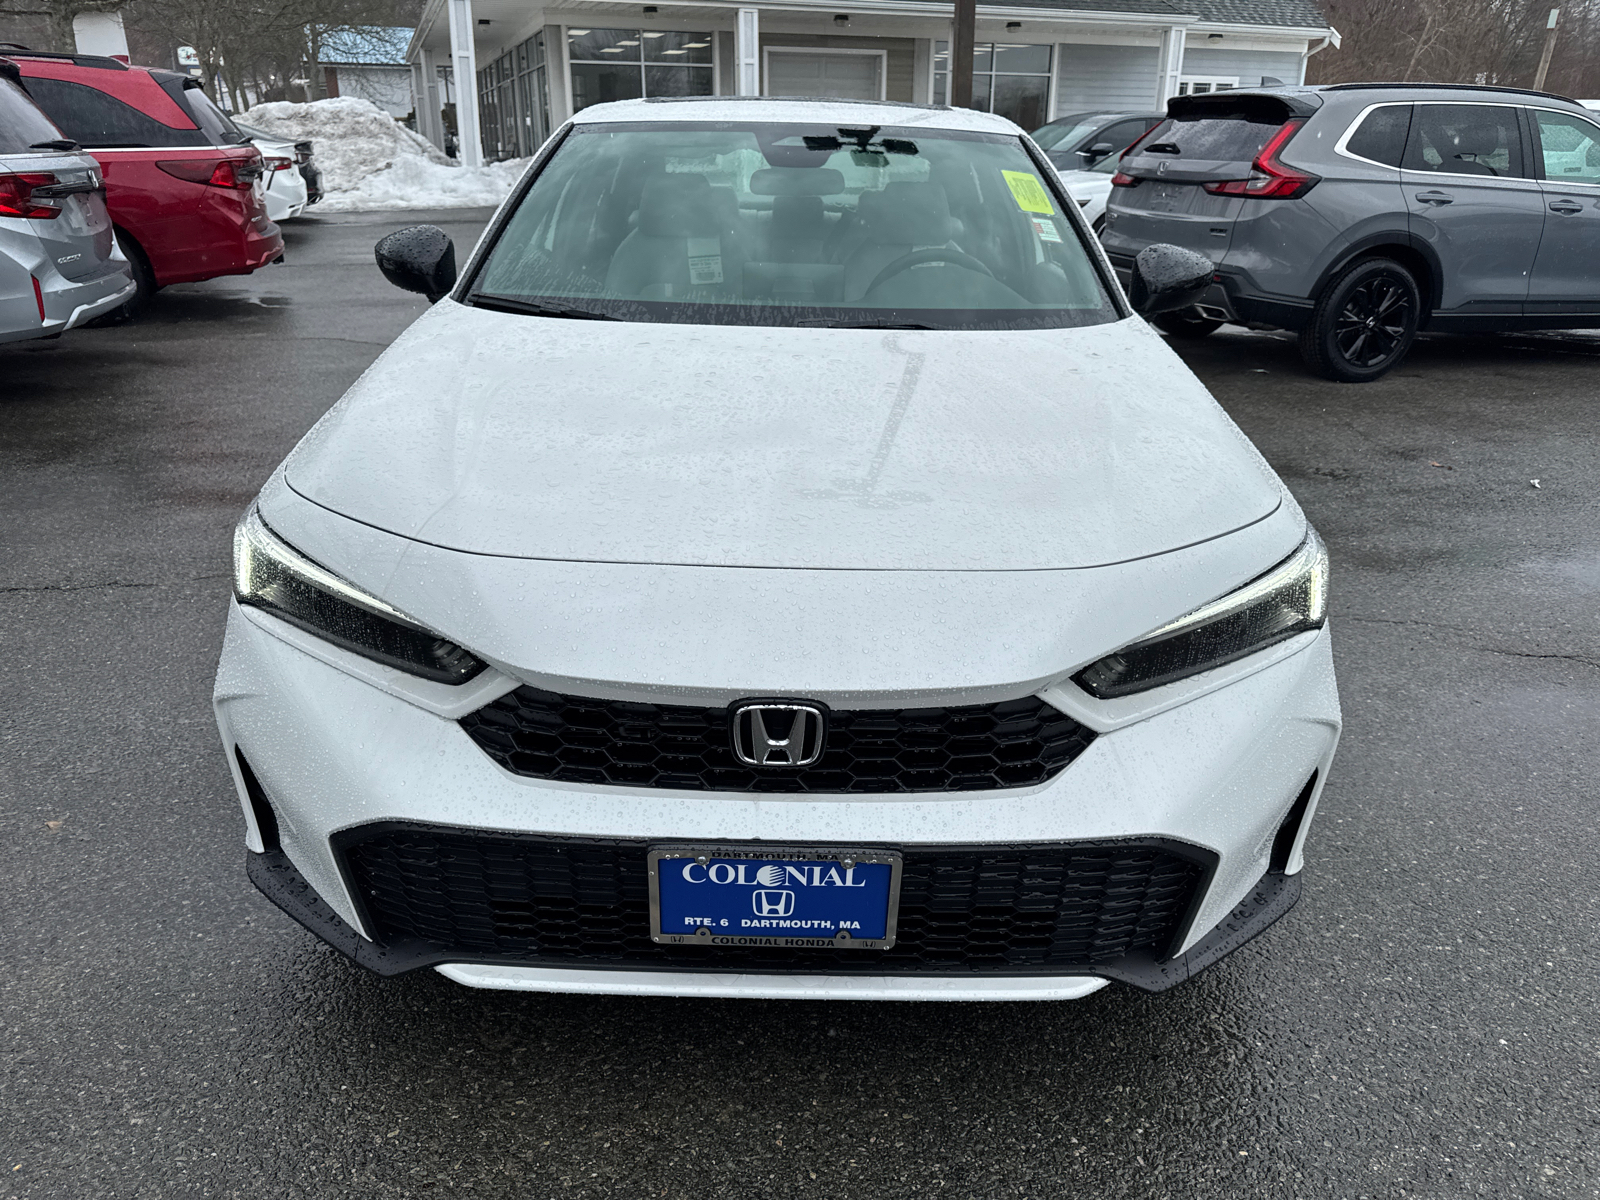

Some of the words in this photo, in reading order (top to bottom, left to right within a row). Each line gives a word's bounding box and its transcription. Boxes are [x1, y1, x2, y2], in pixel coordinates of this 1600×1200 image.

[682, 862, 866, 887] COLONIAL
[684, 916, 716, 927] RTE.
[719, 918, 729, 927] 6
[741, 919, 835, 930] DARTMOUTH,
[839, 920, 861, 930] MA
[711, 936, 781, 946] COLONIAL
[784, 939, 835, 947] HONDA
